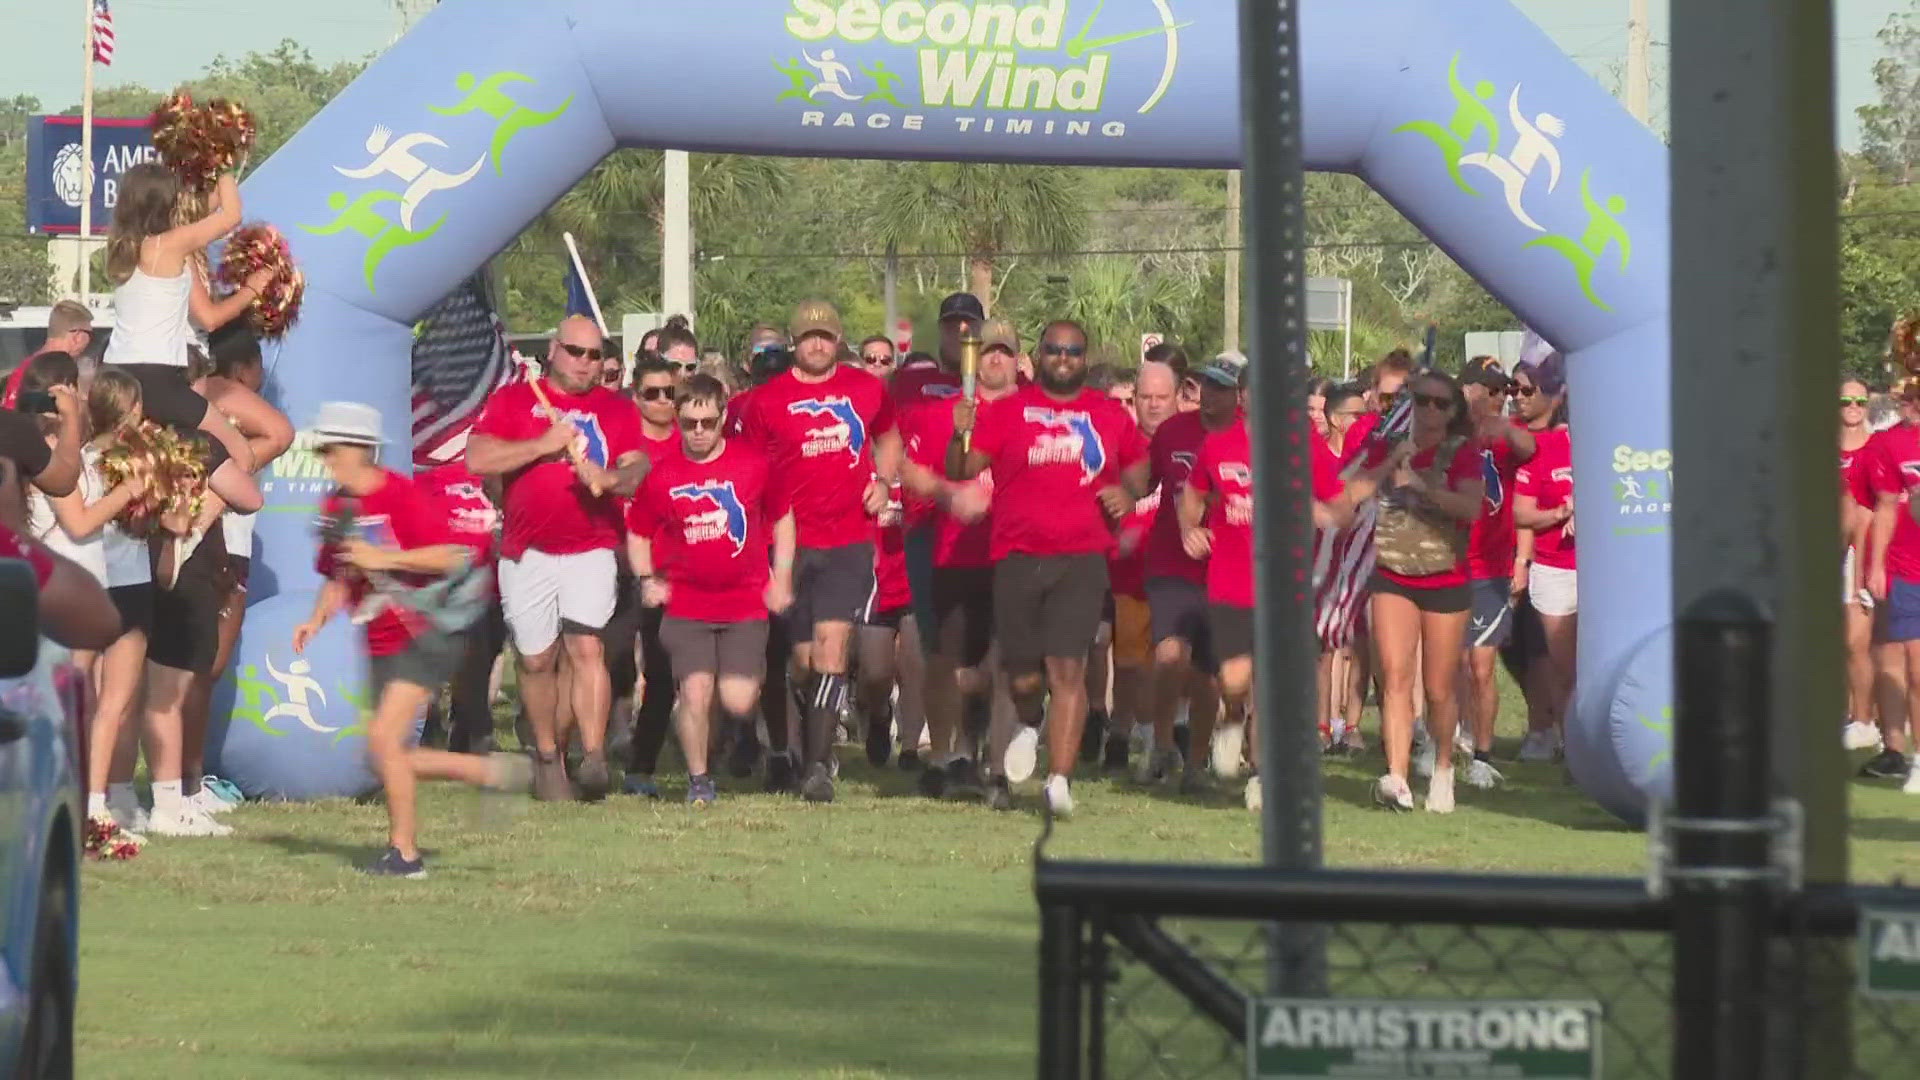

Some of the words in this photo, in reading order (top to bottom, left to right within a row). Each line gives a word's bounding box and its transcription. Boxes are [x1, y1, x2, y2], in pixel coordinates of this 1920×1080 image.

[785, 0, 1067, 48] Second
[919, 49, 1109, 111] Wind
[801, 111, 924, 130] RACE
[955, 117, 1126, 137] TIMING
[103, 144, 163, 174] AME
[271, 450, 334, 479] Win
[1612, 444, 1673, 473] Sec
[1262, 1005, 1588, 1048] ARMSTRONG
